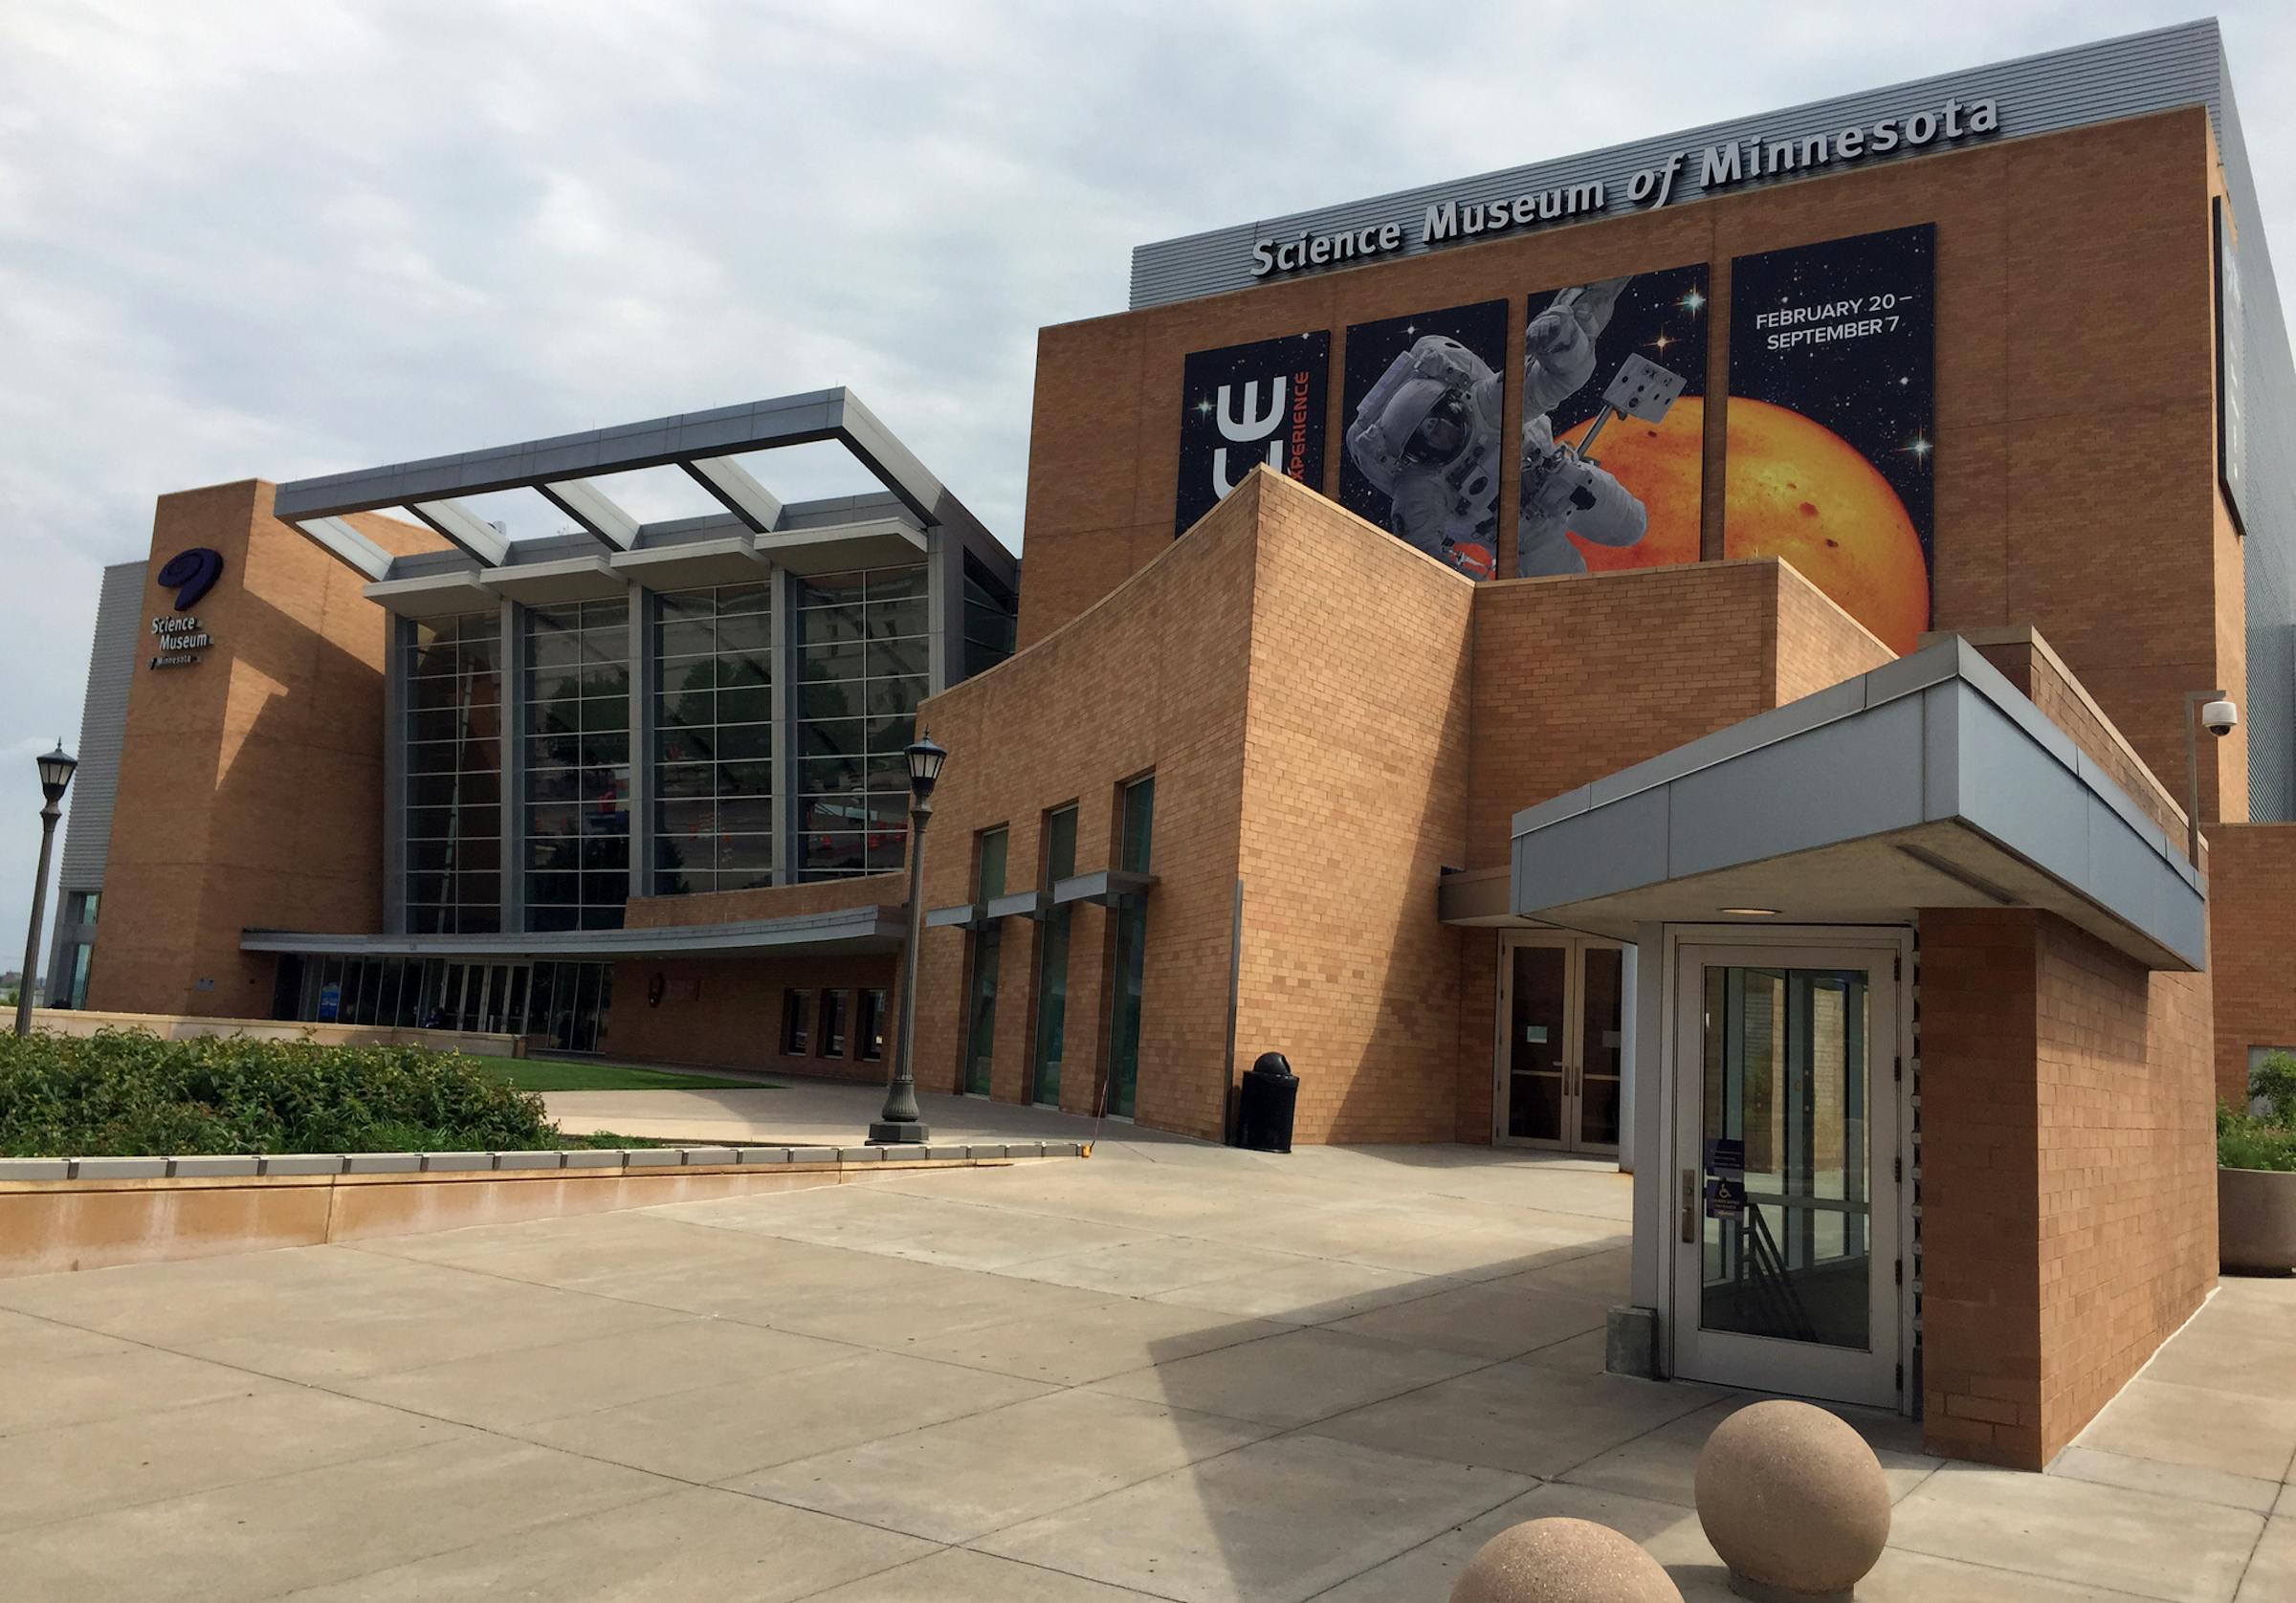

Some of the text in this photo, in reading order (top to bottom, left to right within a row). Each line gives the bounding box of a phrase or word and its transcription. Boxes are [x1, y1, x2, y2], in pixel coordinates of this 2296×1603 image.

[1249, 97, 1998, 276] Science Museum of Minnesota
[1755, 297, 1864, 330] FEBRUARY
[1766, 315, 1900, 351] SEPTEMBER 7
[151, 617, 195, 634] Science
[160, 634, 207, 650] Museum
